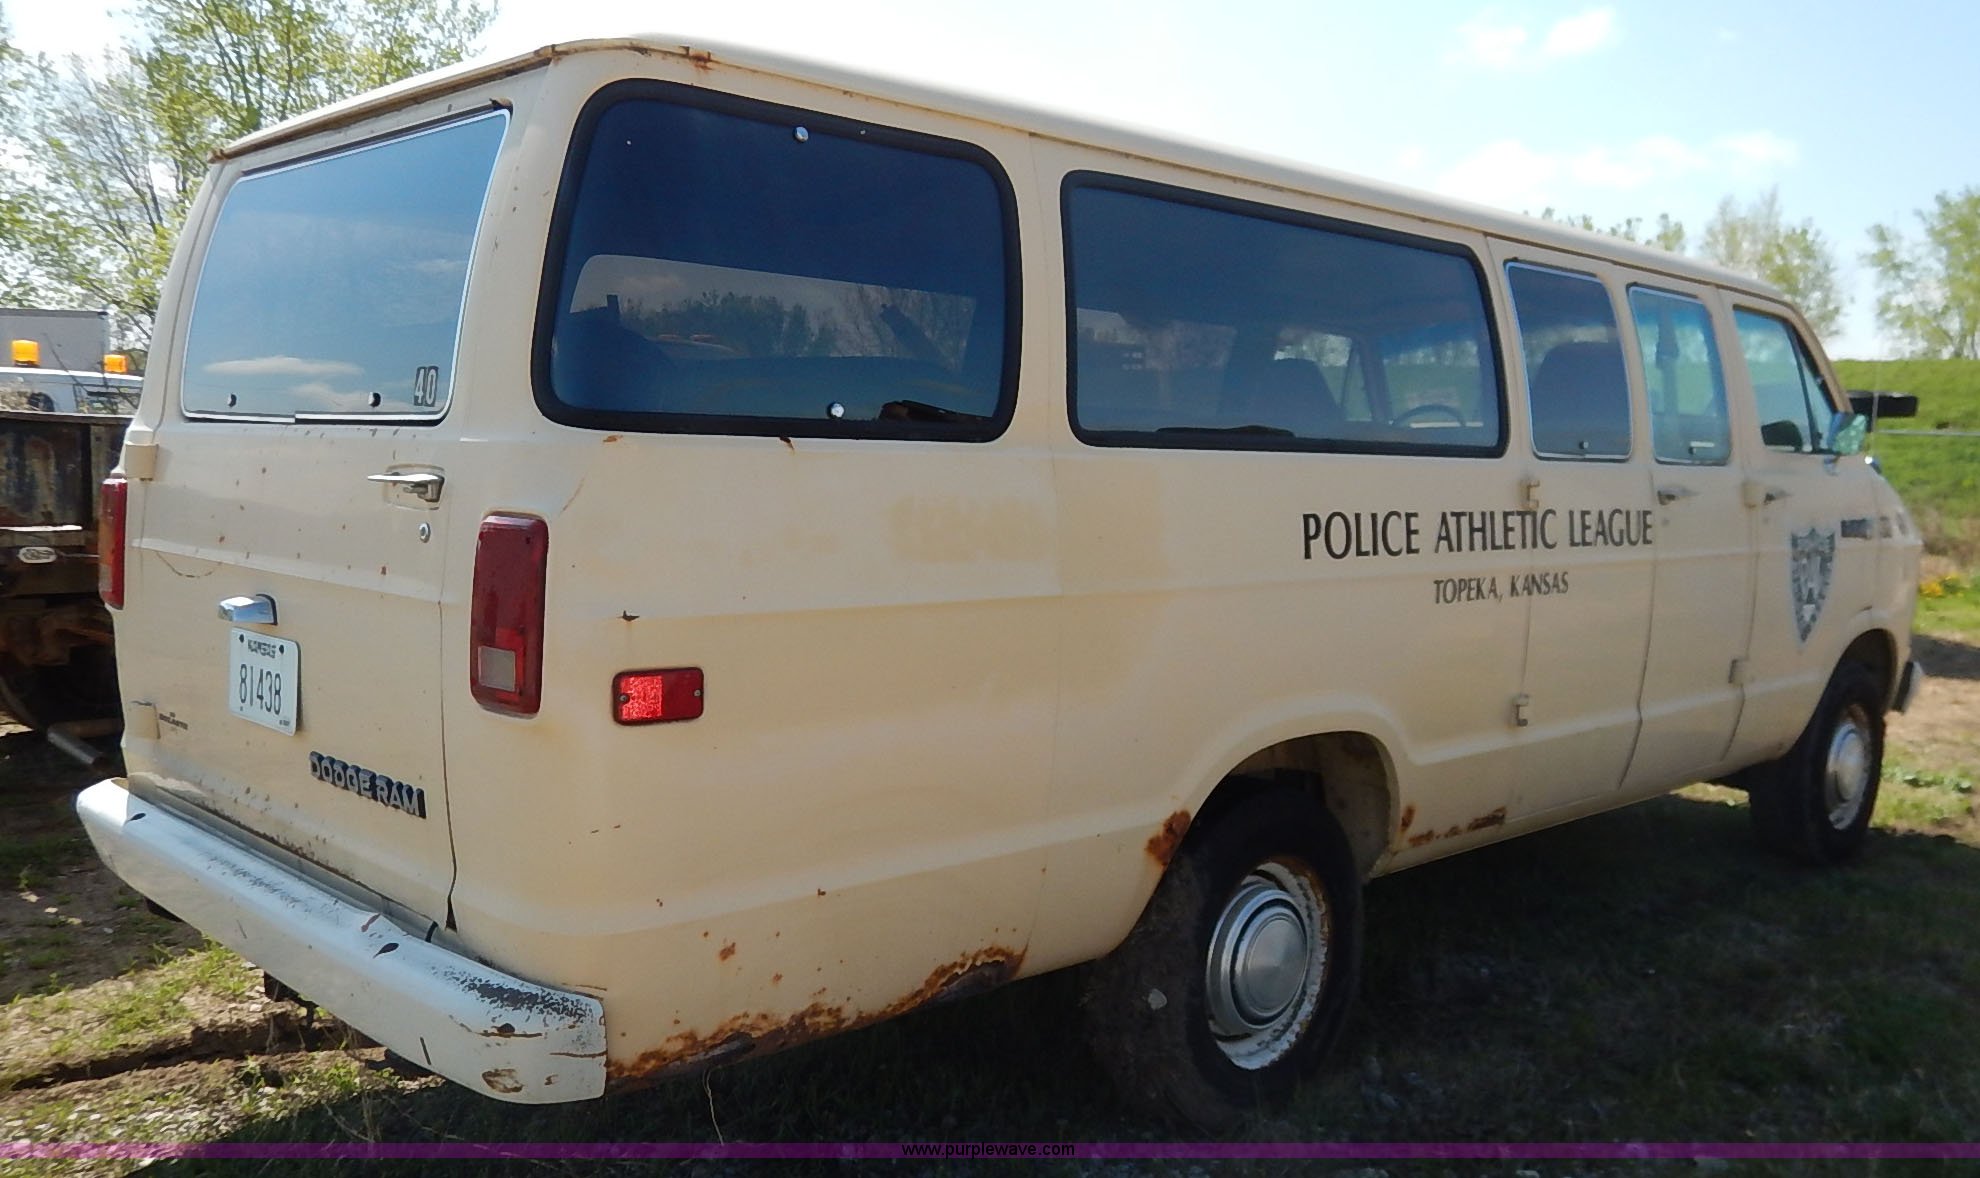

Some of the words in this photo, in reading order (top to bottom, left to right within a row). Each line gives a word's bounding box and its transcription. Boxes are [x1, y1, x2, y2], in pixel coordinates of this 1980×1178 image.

[414, 366, 439, 407] 40
[1302, 510, 1420, 560] POLICE
[1434, 509, 1558, 554] ATHLETIC
[1568, 508, 1654, 548] LEAGUE
[1433, 575, 1503, 604] TOPEKA,
[1509, 571, 1569, 599] KANSAS
[239, 663, 282, 716] 81438
[309, 750, 377, 802] DODGE
[375, 774, 427, 820] RAM
